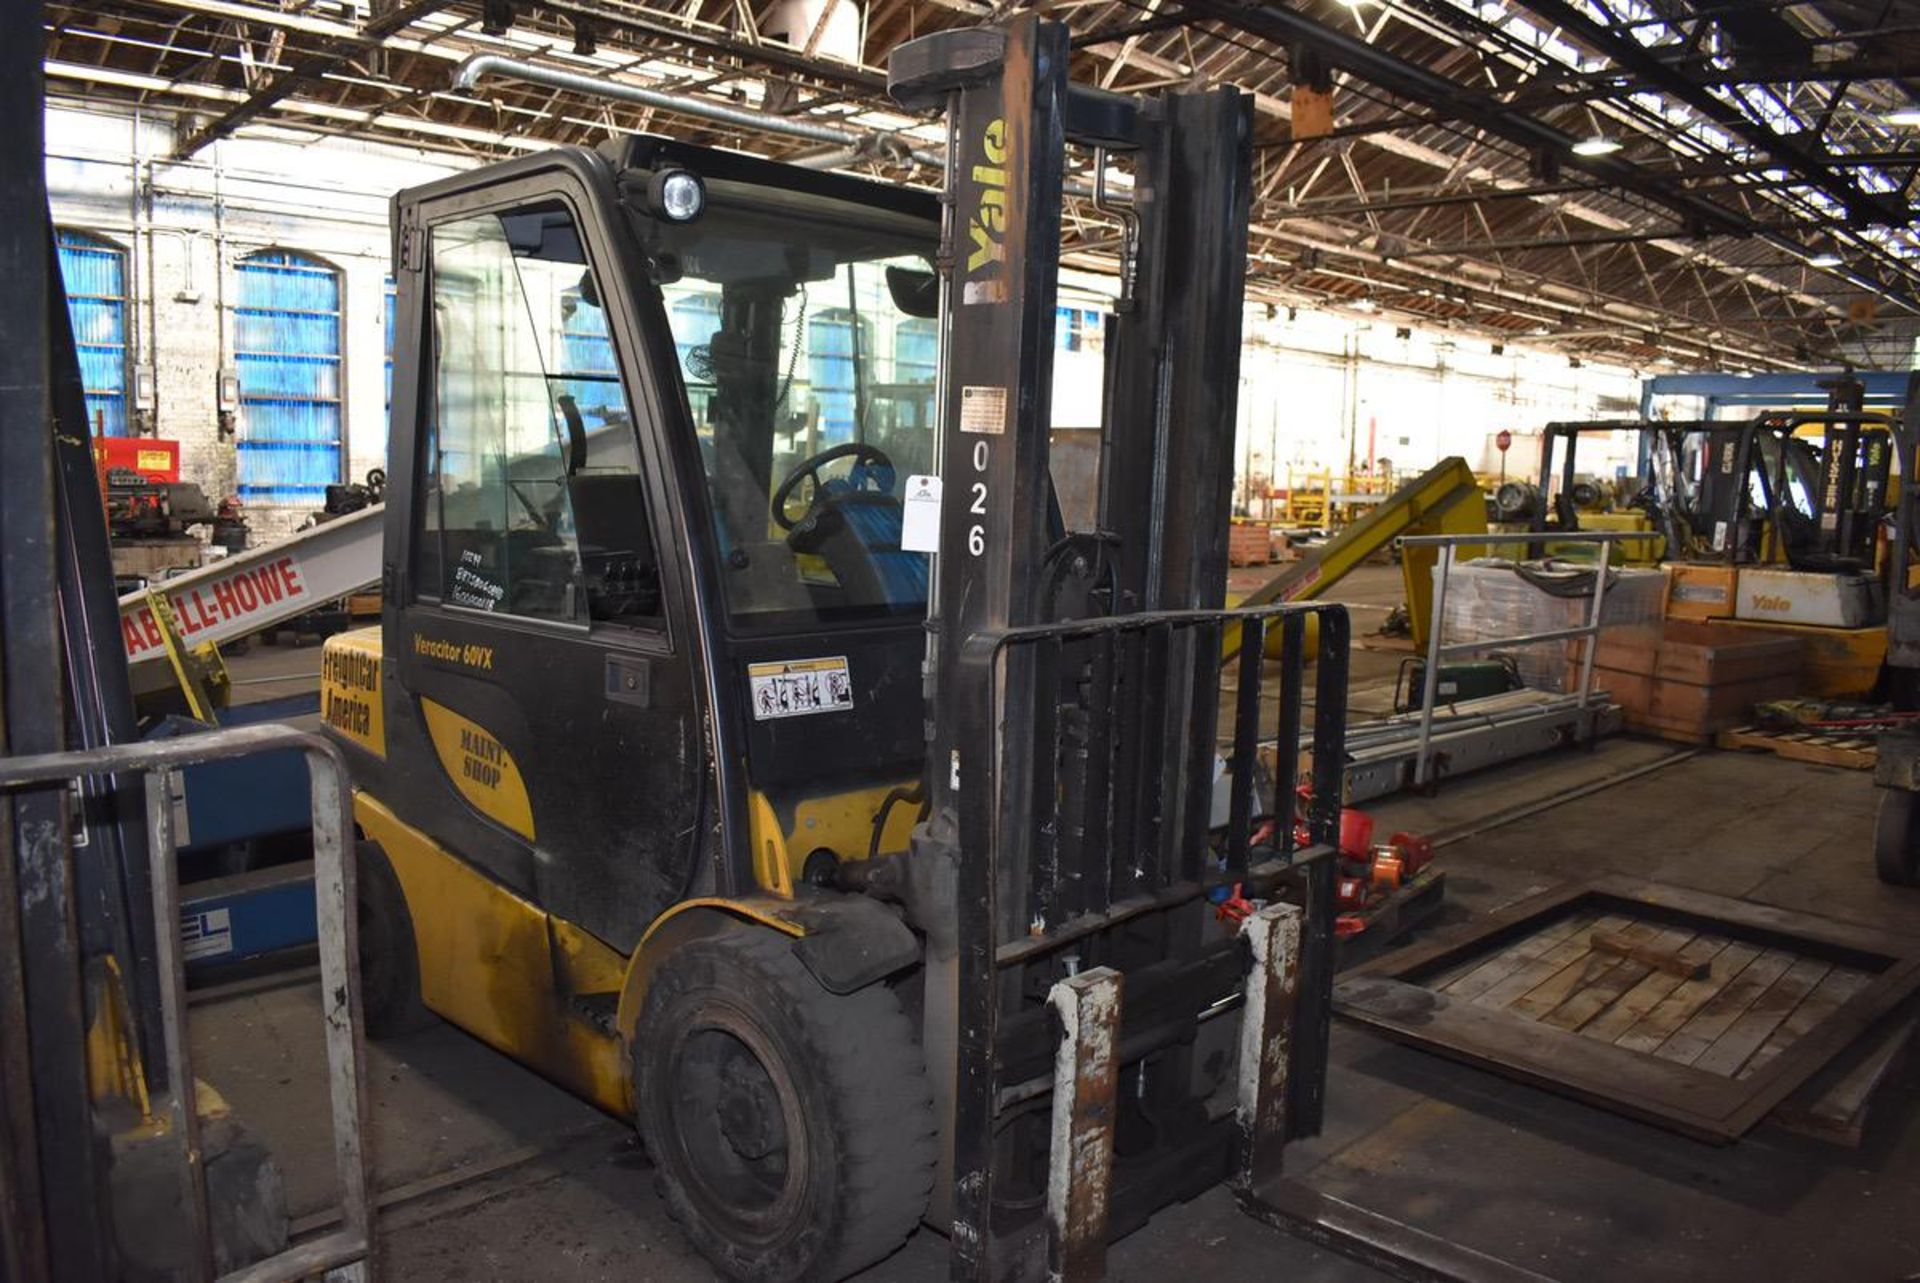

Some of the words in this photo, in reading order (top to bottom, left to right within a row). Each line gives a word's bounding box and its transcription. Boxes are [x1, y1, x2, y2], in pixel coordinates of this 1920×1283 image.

[966, 117, 1011, 272] Yale
[1752, 594, 1792, 611] Yale
[415, 634, 461, 662] Veracitor
[325, 687, 370, 737] America
[463, 756, 501, 790] SHOP
